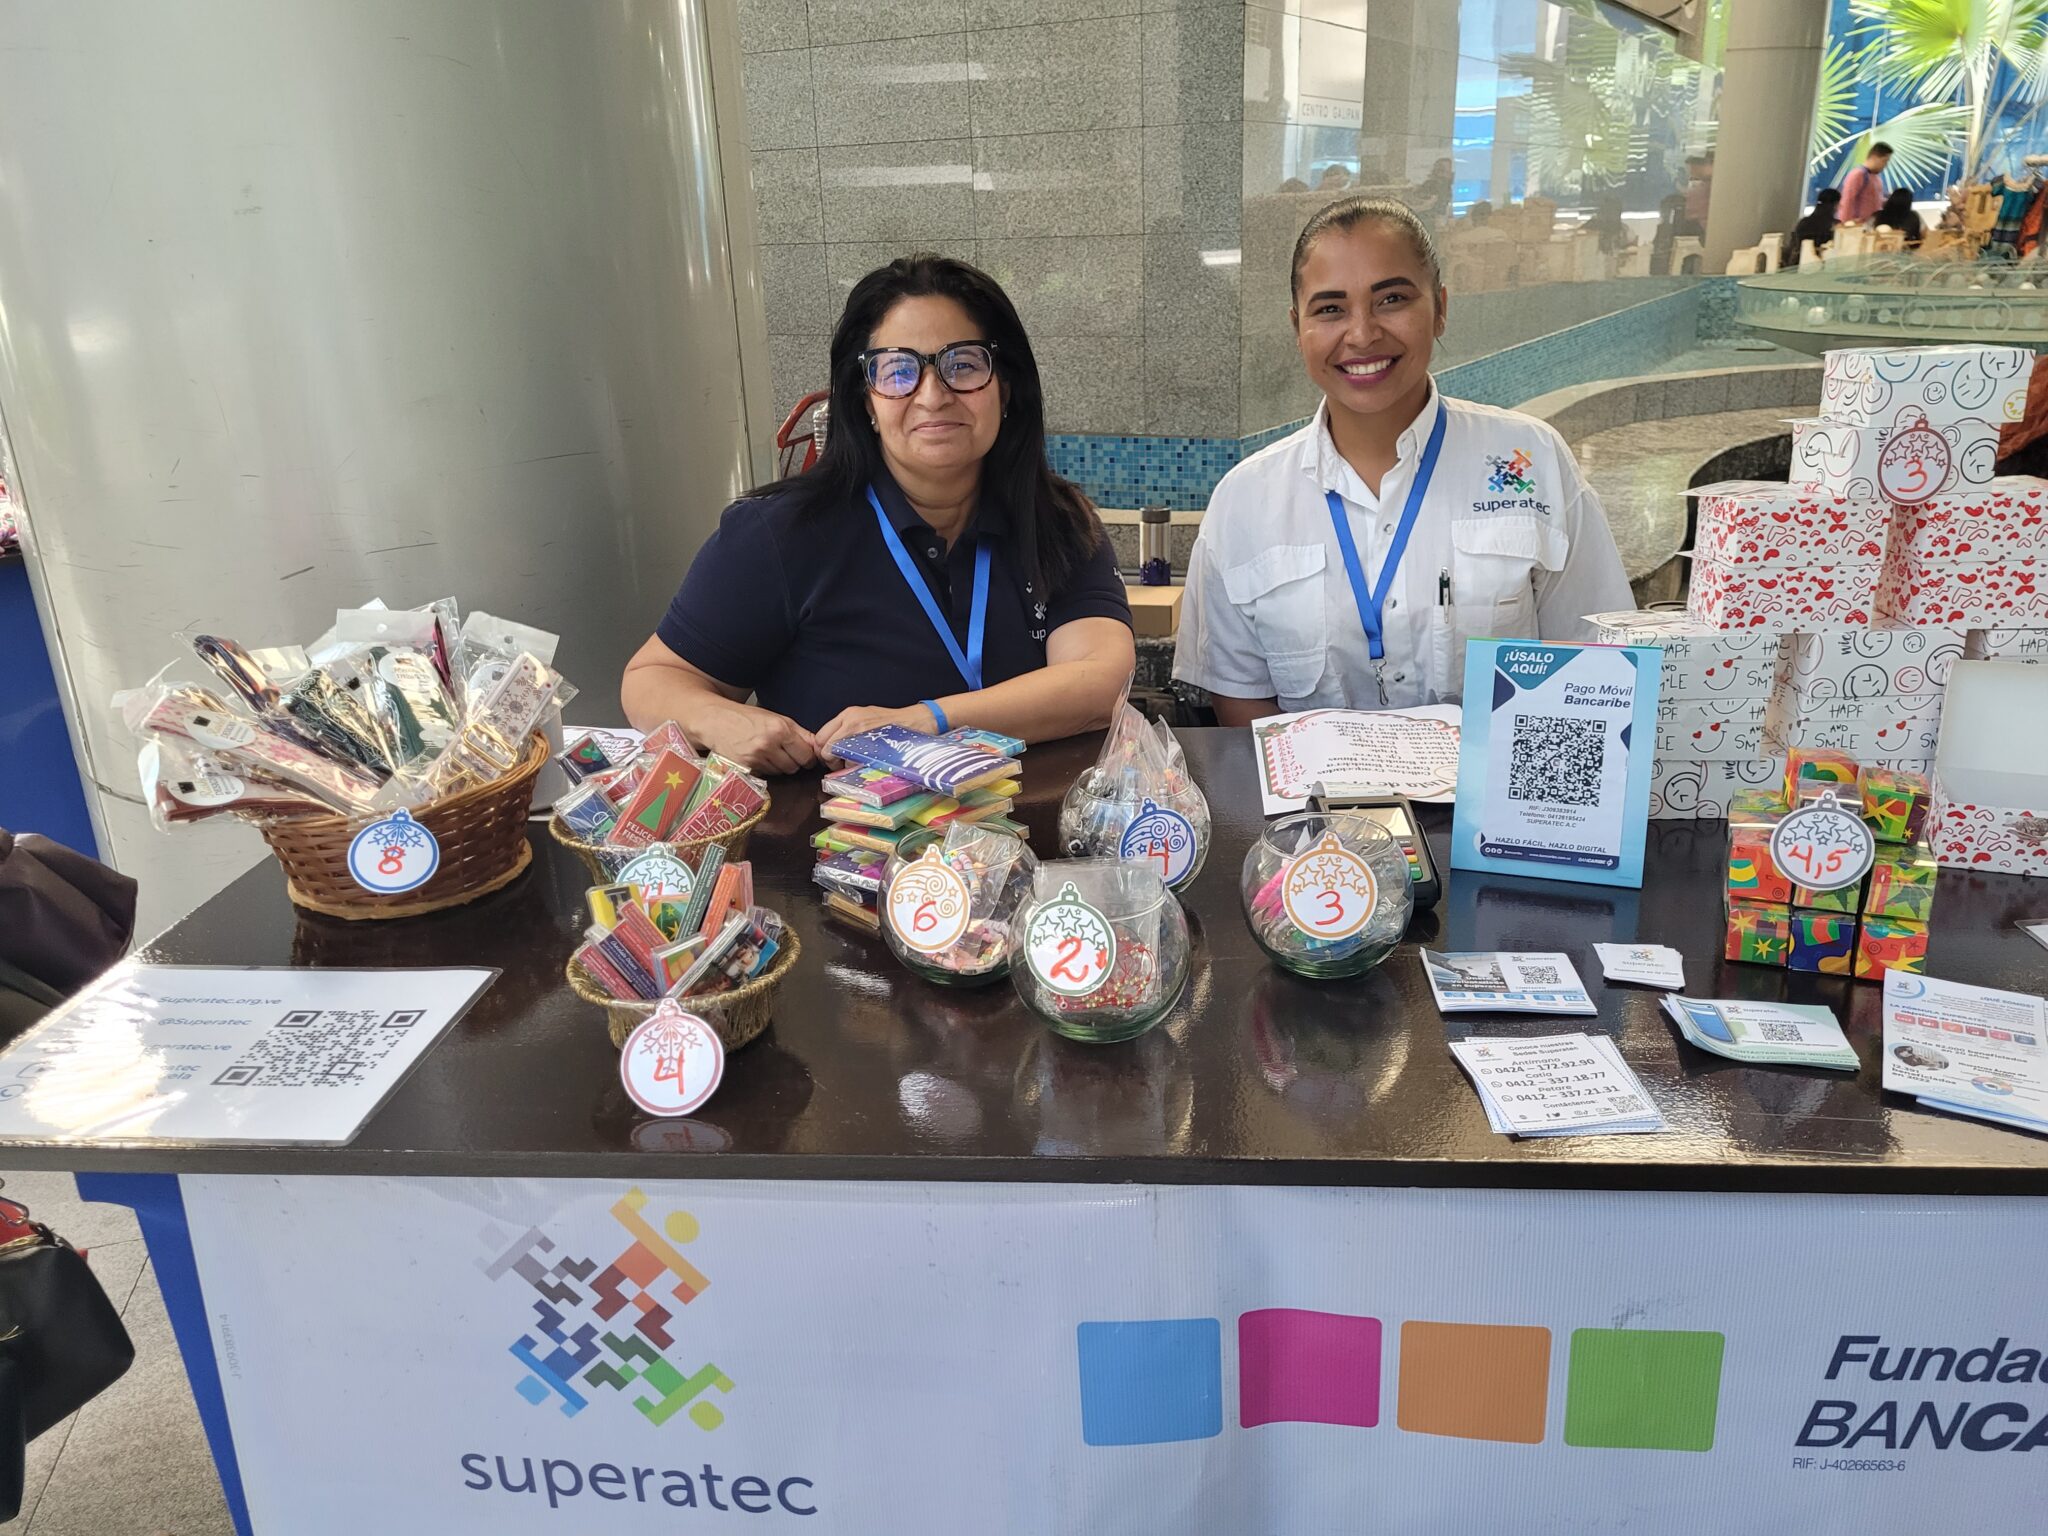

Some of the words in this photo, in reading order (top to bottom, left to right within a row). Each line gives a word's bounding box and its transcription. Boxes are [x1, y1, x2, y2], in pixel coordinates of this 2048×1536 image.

[1301, 103, 1328, 118] CENTRO
[1896, 457, 1928, 493] 3
[1472, 498, 1550, 516] superatec
[1504, 648, 1555, 663] ¡ÚSALO
[1510, 661, 1548, 675] AQUÍ!
[1564, 682, 1596, 696] Pago
[1599, 684, 1633, 696] Móvil
[1564, 694, 1631, 708] Bancaribe
[1830, 724, 1848, 733] AND
[1495, 836, 1521, 845] HAZLO
[1548, 842, 1574, 850] HAZLO
[1576, 844, 1607, 854] DIGITAL
[378, 846, 406, 875] 8
[1148, 837, 1170, 876] 4
[1788, 844, 1850, 880] 4,5
[912, 900, 938, 932] 6
[1314, 890, 1345, 926] 3
[158, 1017, 252, 1026] @Superatec
[654, 1047, 685, 1096] 4
[1495, 1065, 1525, 1074] 0424
[1538, 1058, 1595, 1071] 172.92.90
[1506, 1078, 1535, 1088] 0412
[1549, 1072, 1606, 1085] 337.18.77
[1516, 1092, 1545, 1101] 0412
[1560, 1085, 1620, 1098] 337.21.31
[1538, 1084, 1572, 1093] Petare
[1792, 1458, 1816, 1470] RIF:
[1819, 1458, 1906, 1472] J-40266563-6
[460, 1452, 818, 1516] superatec
